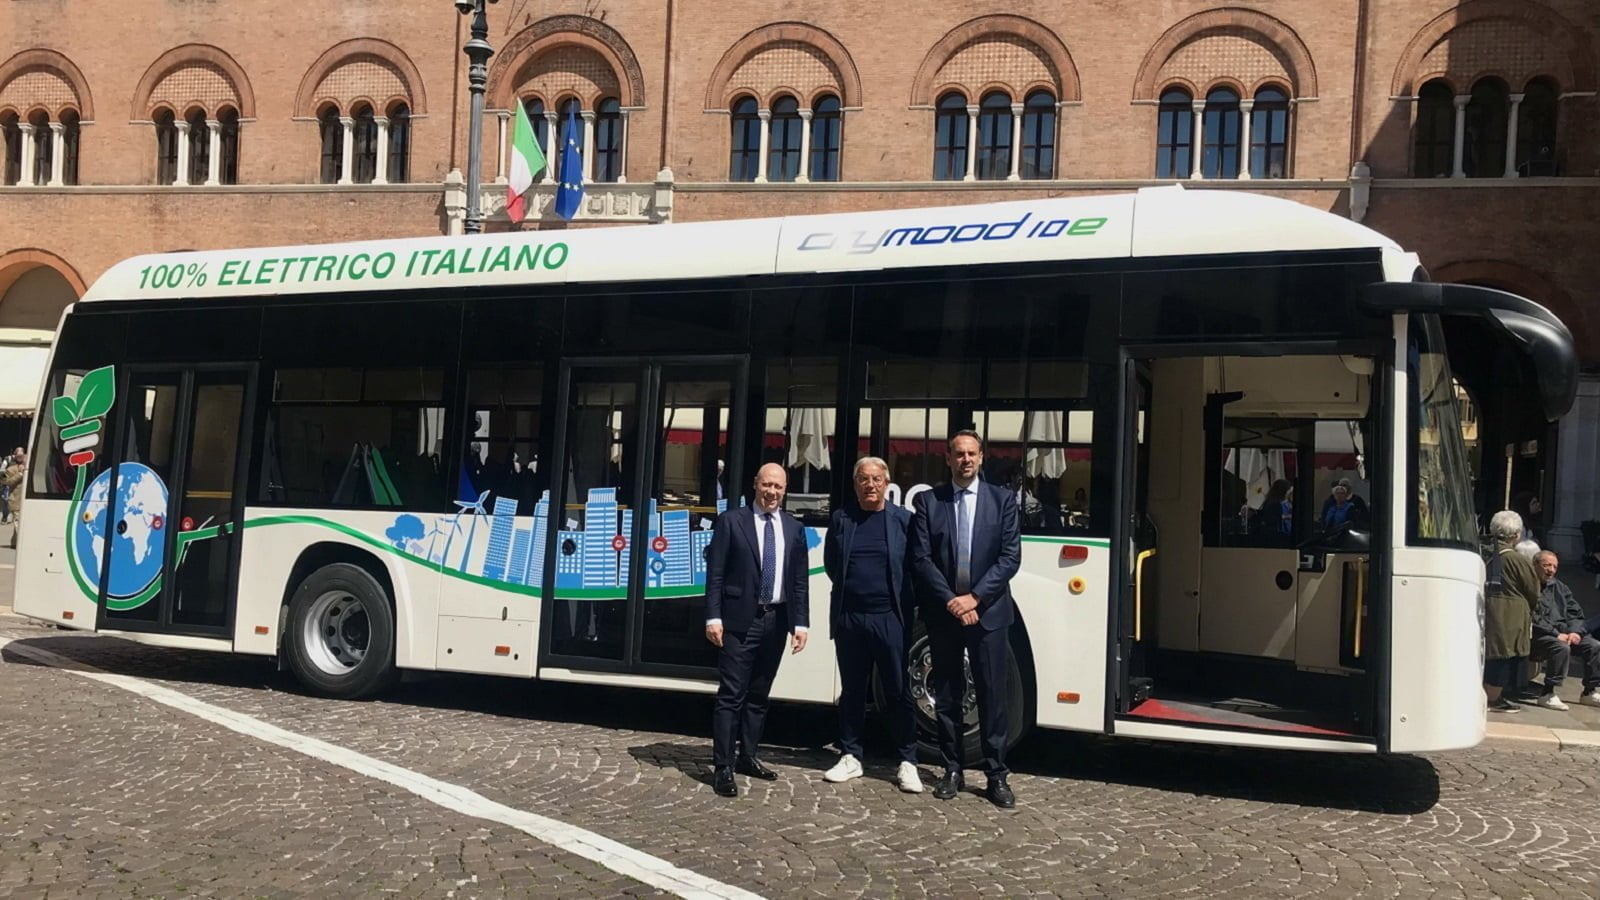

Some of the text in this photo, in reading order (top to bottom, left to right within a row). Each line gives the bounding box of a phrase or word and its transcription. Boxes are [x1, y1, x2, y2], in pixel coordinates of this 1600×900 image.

[1026, 217, 1108, 239] 10e
[138, 242, 569, 289] 100% ELETTRICO ITALIANO
